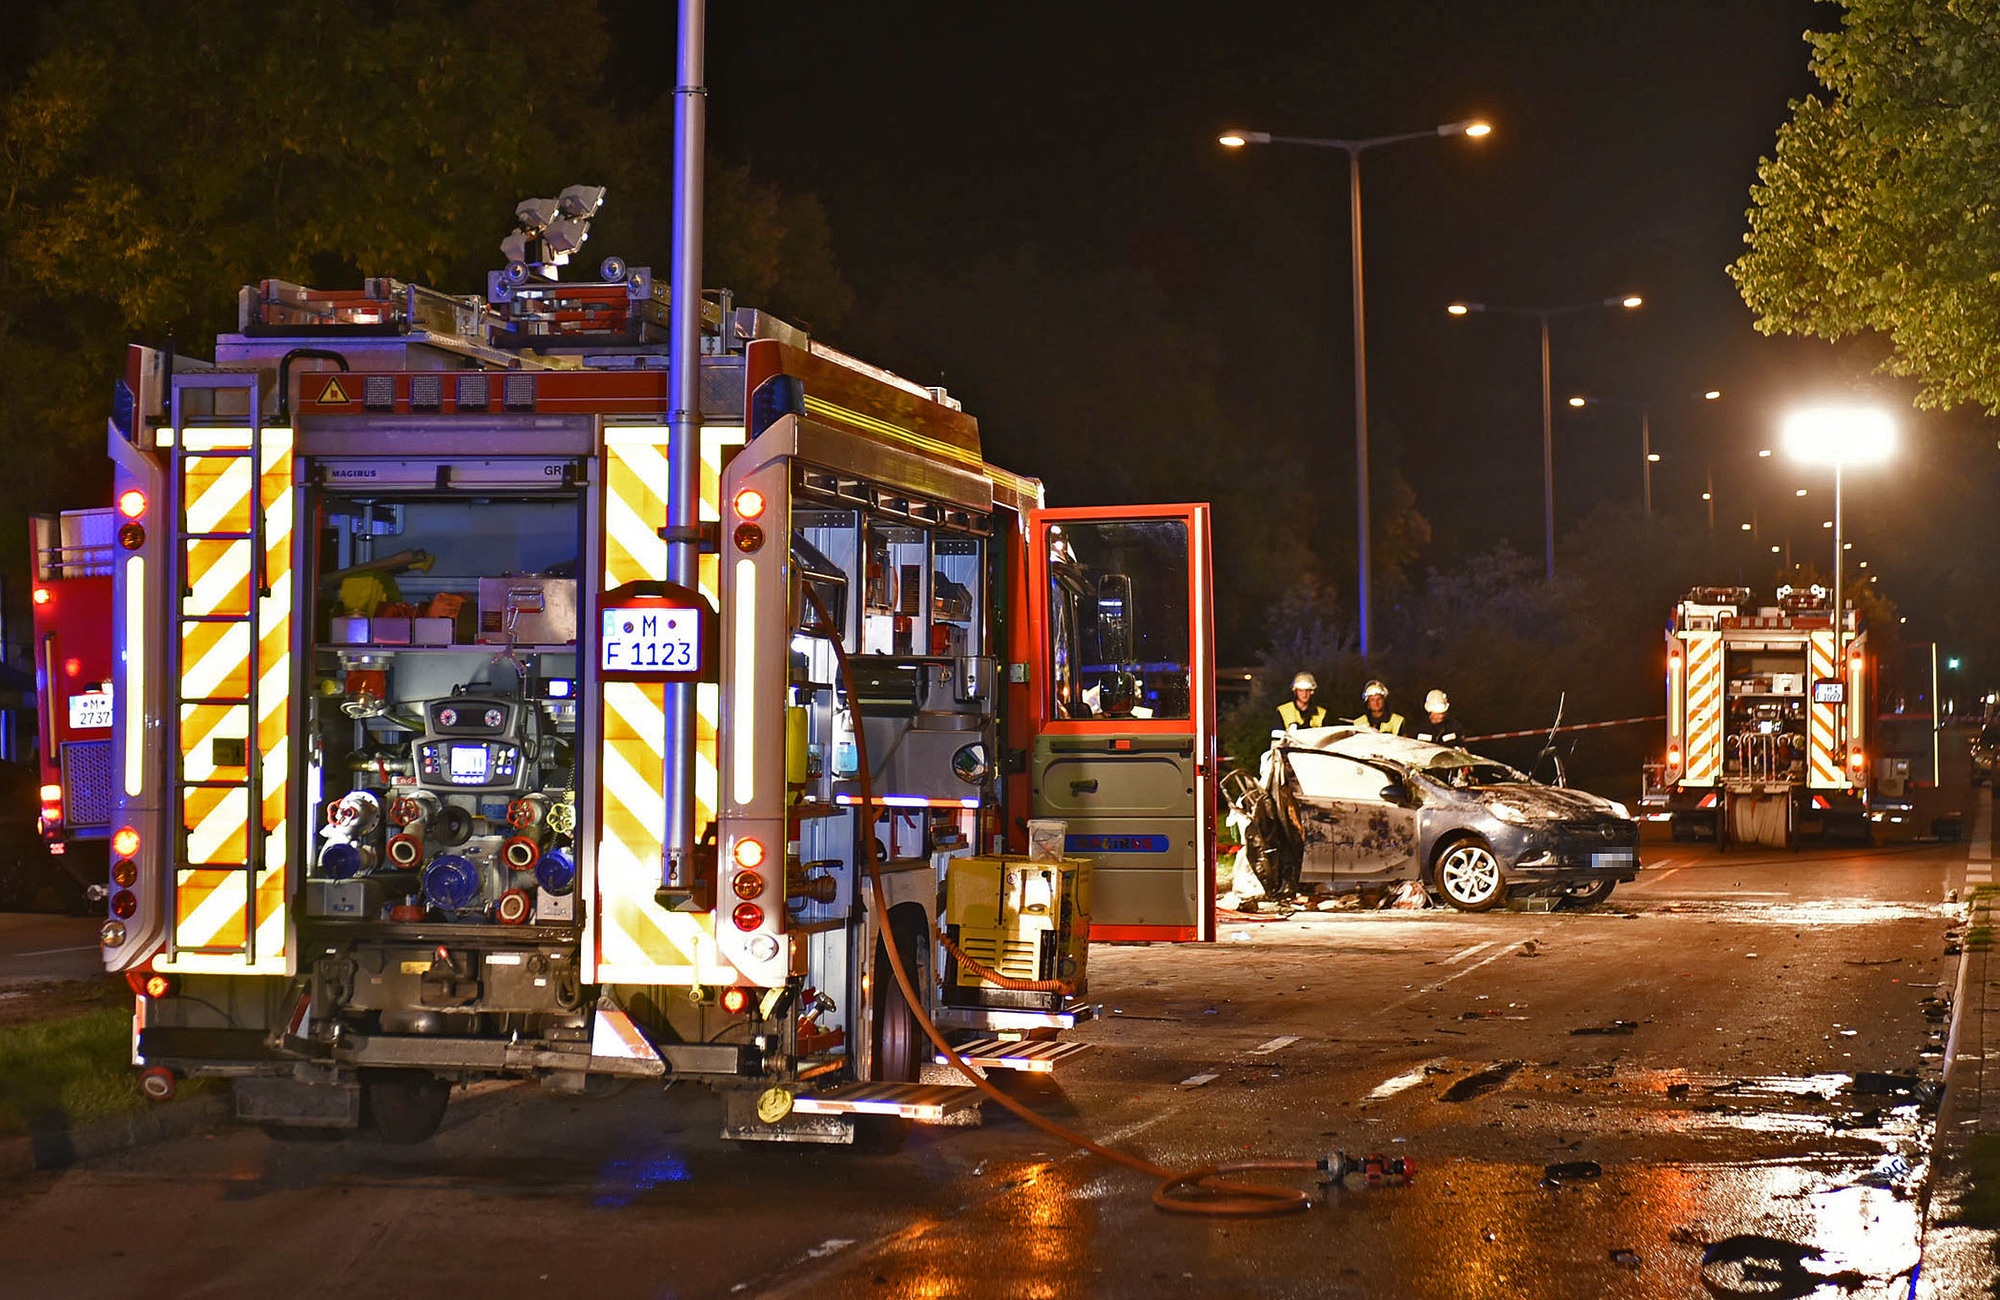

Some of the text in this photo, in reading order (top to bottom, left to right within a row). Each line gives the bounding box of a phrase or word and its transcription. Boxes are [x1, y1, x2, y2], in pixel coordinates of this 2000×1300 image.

[331, 469, 377, 478] MAGIRUS
[642, 615, 657, 637] M
[607, 642, 691, 666] F 1123
[90, 699, 99, 710] M
[80, 711, 110, 725] 2737
